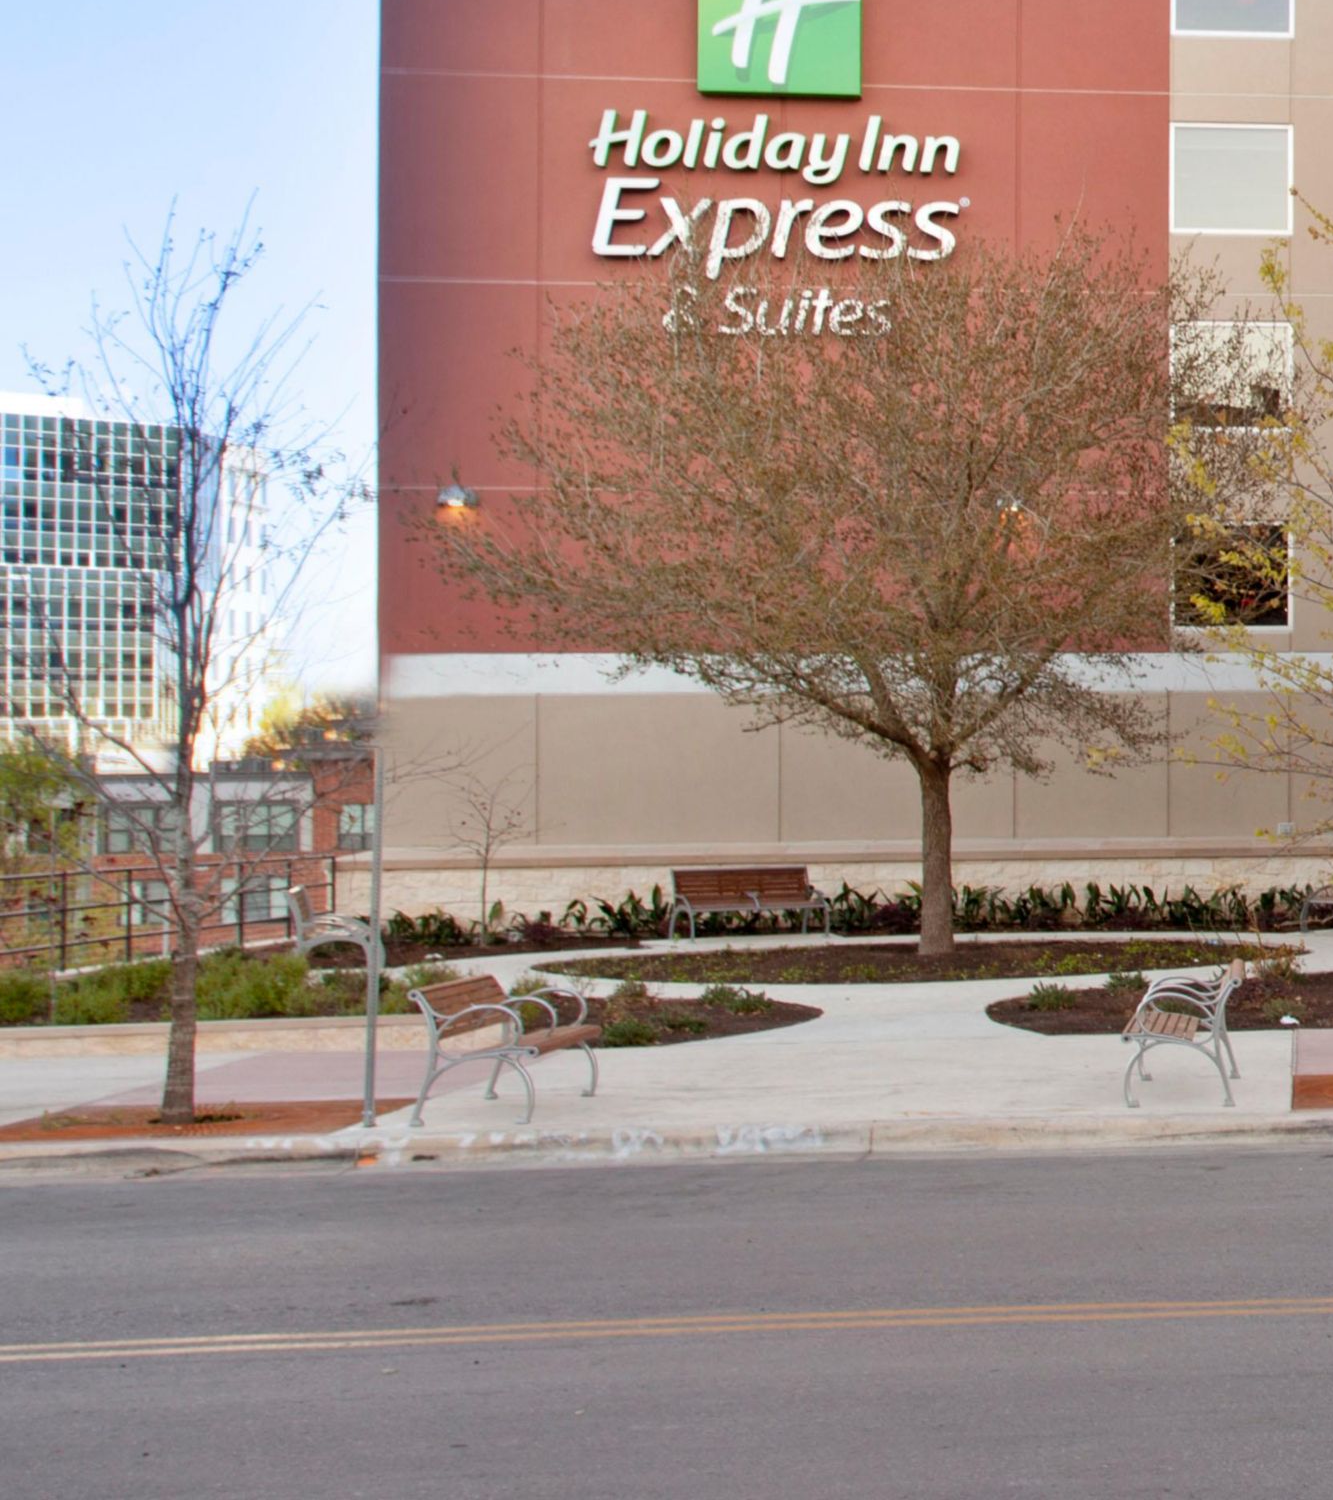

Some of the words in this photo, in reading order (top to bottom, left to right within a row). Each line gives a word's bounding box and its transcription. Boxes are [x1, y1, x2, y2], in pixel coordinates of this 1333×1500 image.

[588, 108, 850, 185] Holiday
[858, 114, 961, 174] Inn
[591, 177, 960, 280] Express
[717, 286, 893, 336] Suites
